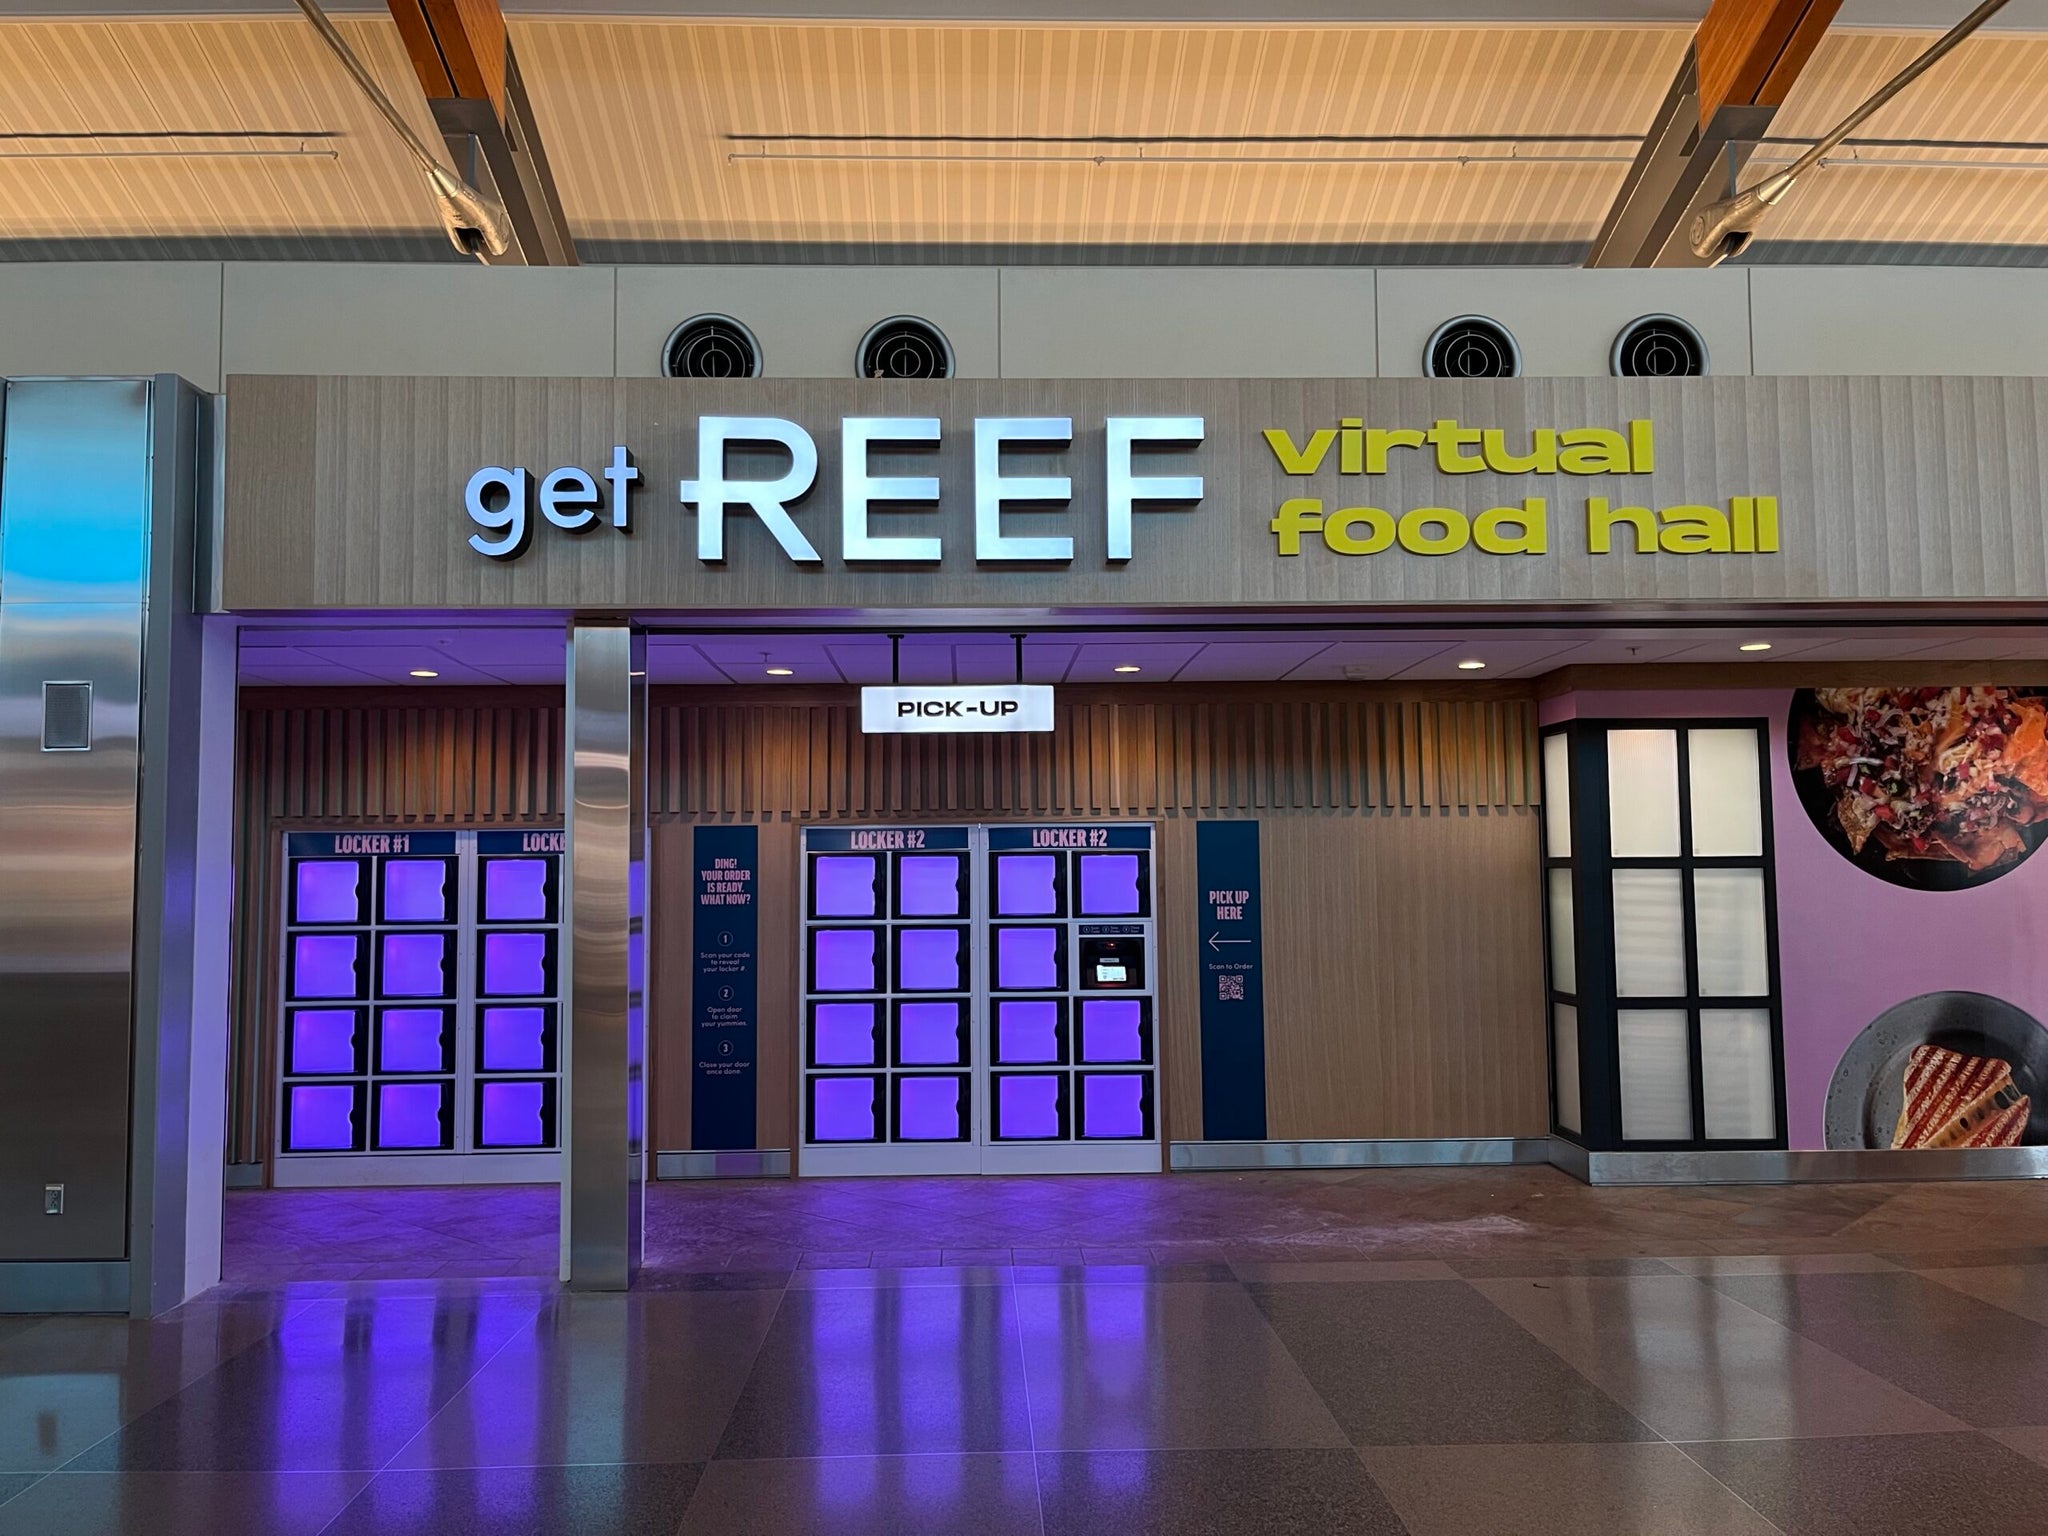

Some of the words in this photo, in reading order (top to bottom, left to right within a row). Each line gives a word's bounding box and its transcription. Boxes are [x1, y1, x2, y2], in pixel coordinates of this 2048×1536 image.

[1263, 417, 1654, 475] virtual
[464, 445, 644, 557] get
[680, 415, 1205, 565] REEF
[1271, 497, 1547, 556] food
[1587, 496, 1779, 555] hall
[897, 701, 1019, 717] PICK-UP
[335, 835, 390, 853] LOCKER
[393, 835, 410, 853] #1
[523, 833, 565, 851] LOCKE
[851, 831, 904, 849] LOCKER
[907, 830, 925, 848] #2
[1033, 829, 1086, 847] LOCKER
[1090, 829, 1107, 847] #2
[715, 858, 737, 869] DING!
[701, 870, 723, 881] YOUR
[724, 870, 751, 880] ORDER
[707, 882, 715, 893] IS
[717, 882, 744, 893] READY.
[701, 894, 724, 905] WHAT
[726, 894, 751, 905] NOW?
[1209, 891, 1234, 904] PICK
[1235, 891, 1250, 904] UP
[1217, 906, 1243, 920] HERE
[723, 989, 729, 998] 2
[723, 1043, 728, 1053] 3
